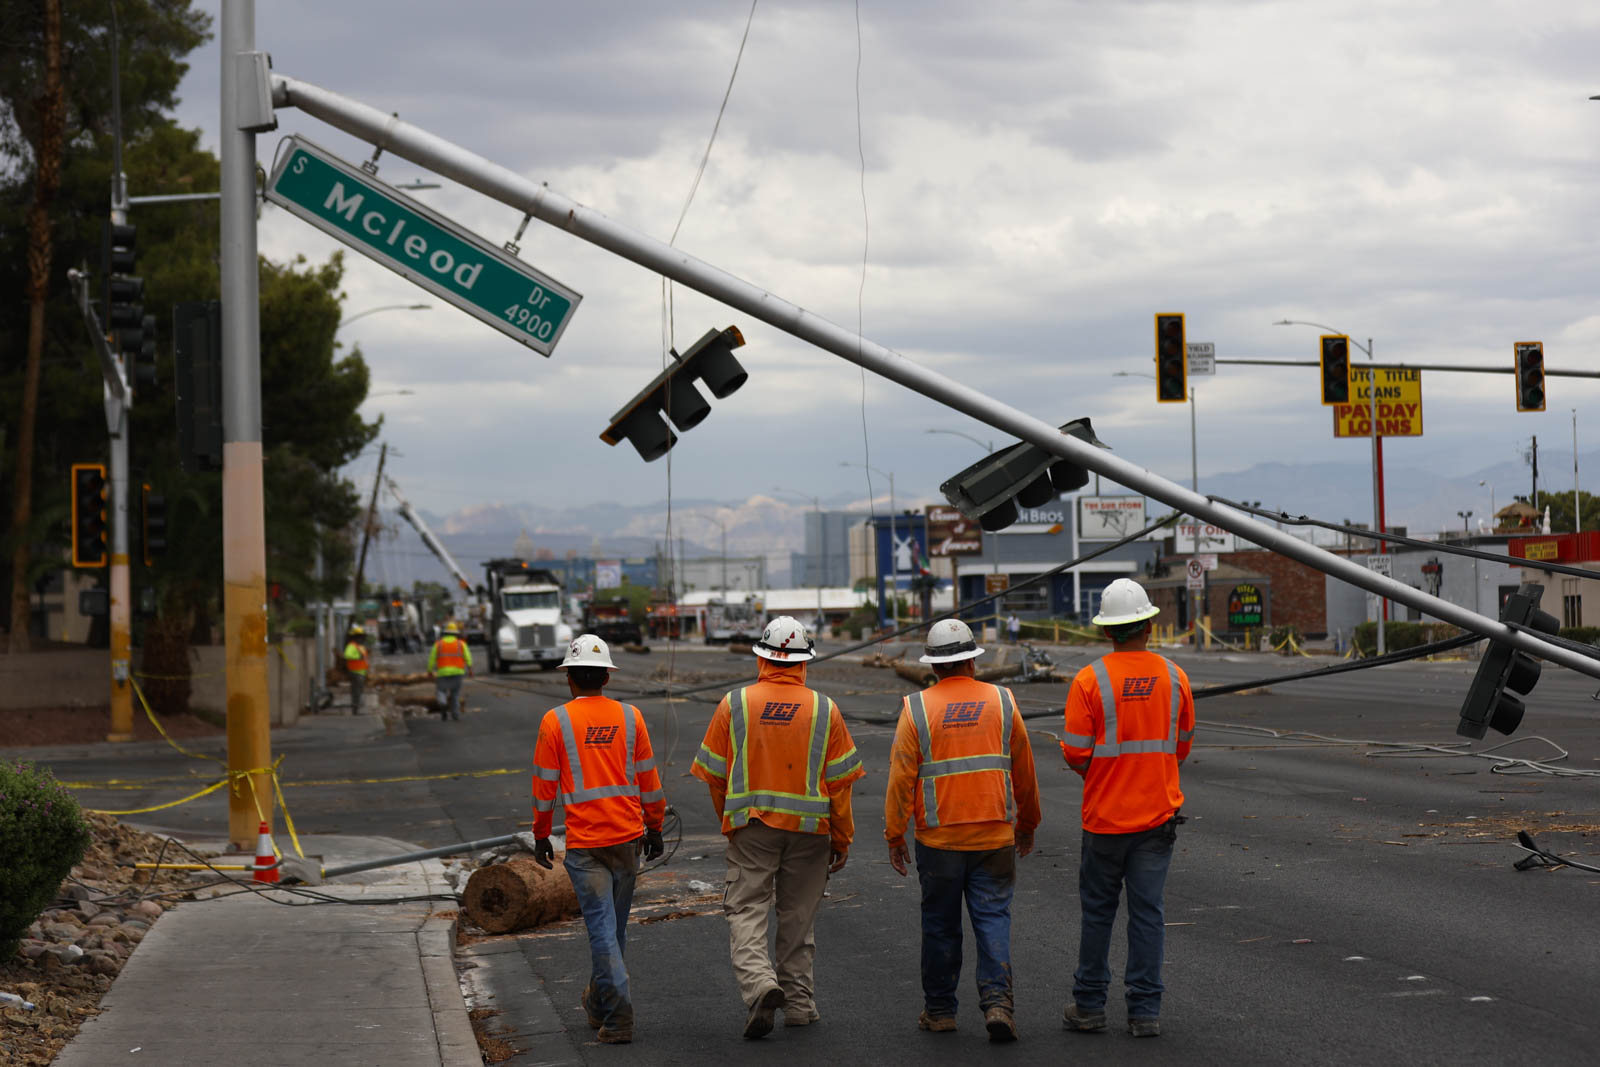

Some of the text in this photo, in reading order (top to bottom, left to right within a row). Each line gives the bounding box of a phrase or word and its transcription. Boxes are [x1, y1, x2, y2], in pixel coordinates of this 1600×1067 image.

[293, 156, 551, 310] S Mcleod Dr
[504, 304, 552, 340] 4900
[1351, 370, 1418, 382] UTO TITLE
[1357, 386, 1401, 398] LOANS
[1340, 403, 1418, 418] PAYDAY
[1348, 420, 1411, 435] LOANS
